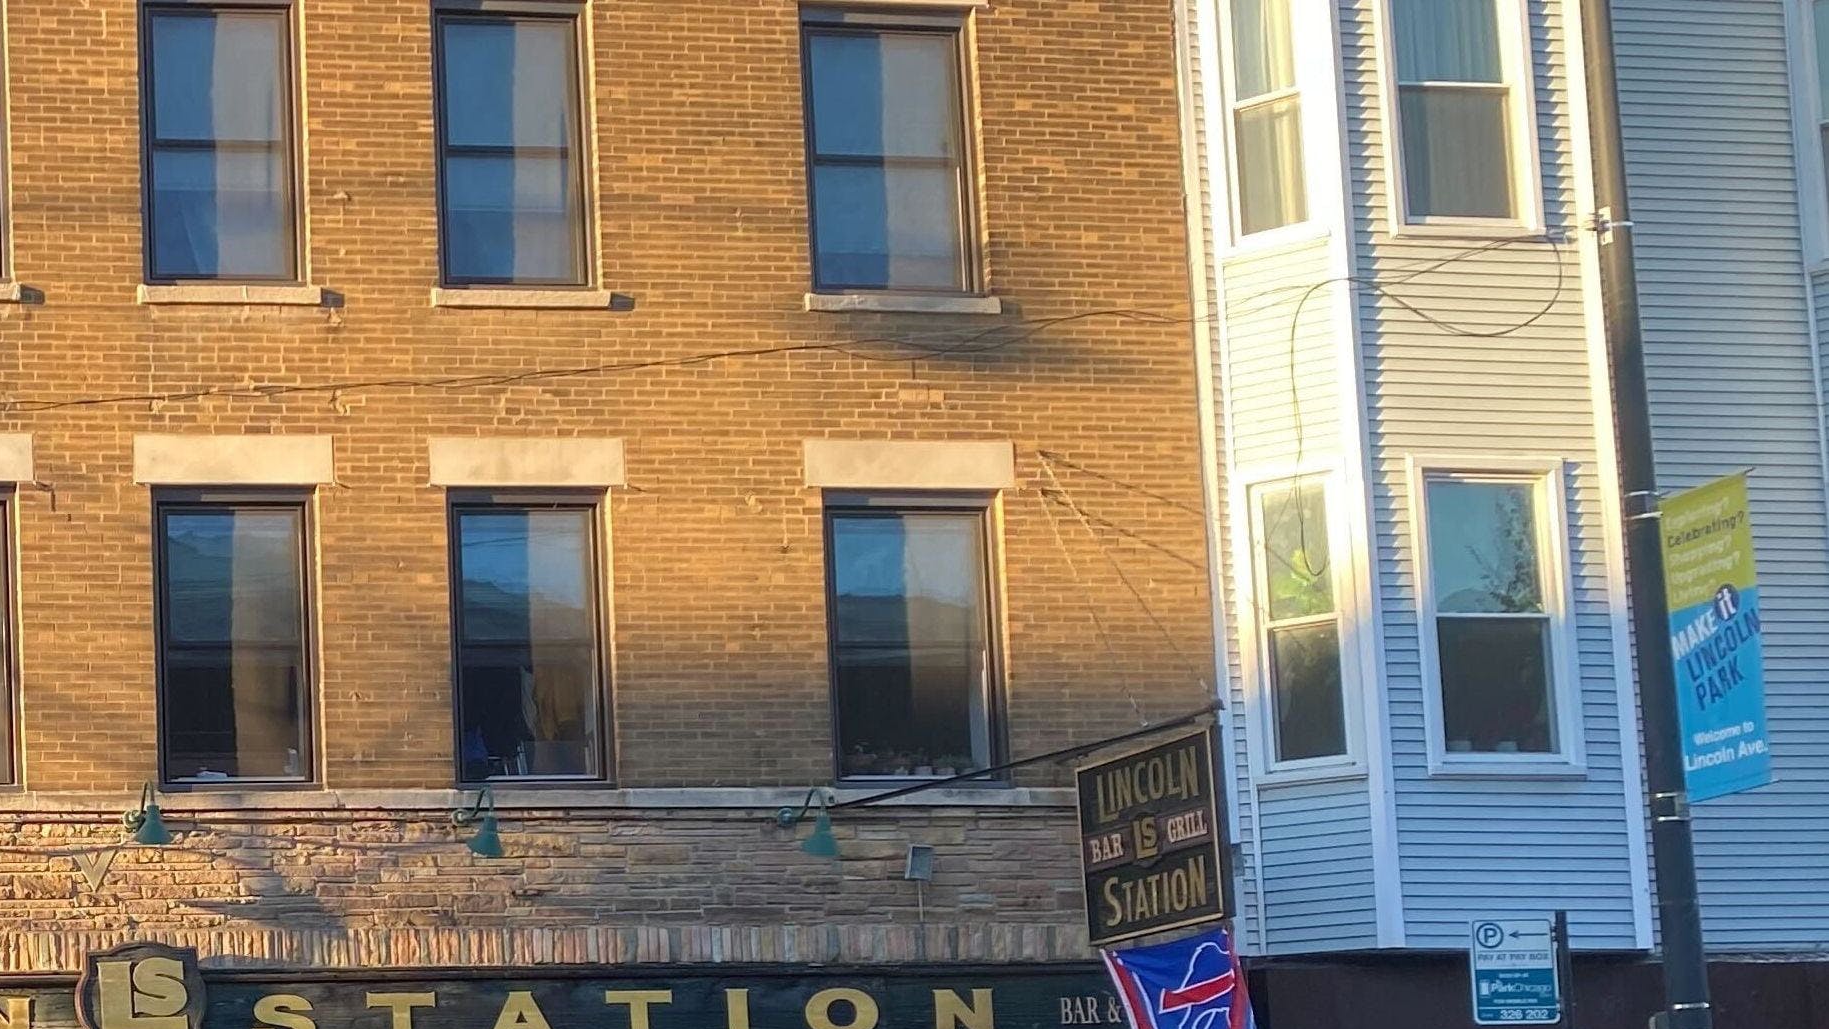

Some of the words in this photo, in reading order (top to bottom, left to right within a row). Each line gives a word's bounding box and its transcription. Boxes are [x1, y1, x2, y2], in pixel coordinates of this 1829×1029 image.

[1671, 608, 1719, 660] MAKE
[1716, 587, 1737, 621] it
[1686, 607, 1760, 682] LINCOLN
[1695, 655, 1746, 711] PARK
[1684, 746, 1735, 772] Lincoln
[1738, 738, 1769, 759] Ave.
[1693, 725, 1741, 746] Welcome
[1742, 721, 1754, 734] to
[1096, 745, 1200, 823] LINCOLN
[1089, 833, 1124, 864] BAR
[1167, 809, 1208, 844] GRILL
[1103, 854, 1206, 928] STATION
[1060, 996, 1102, 1025] BAR
[1107, 996, 1122, 1023] &
